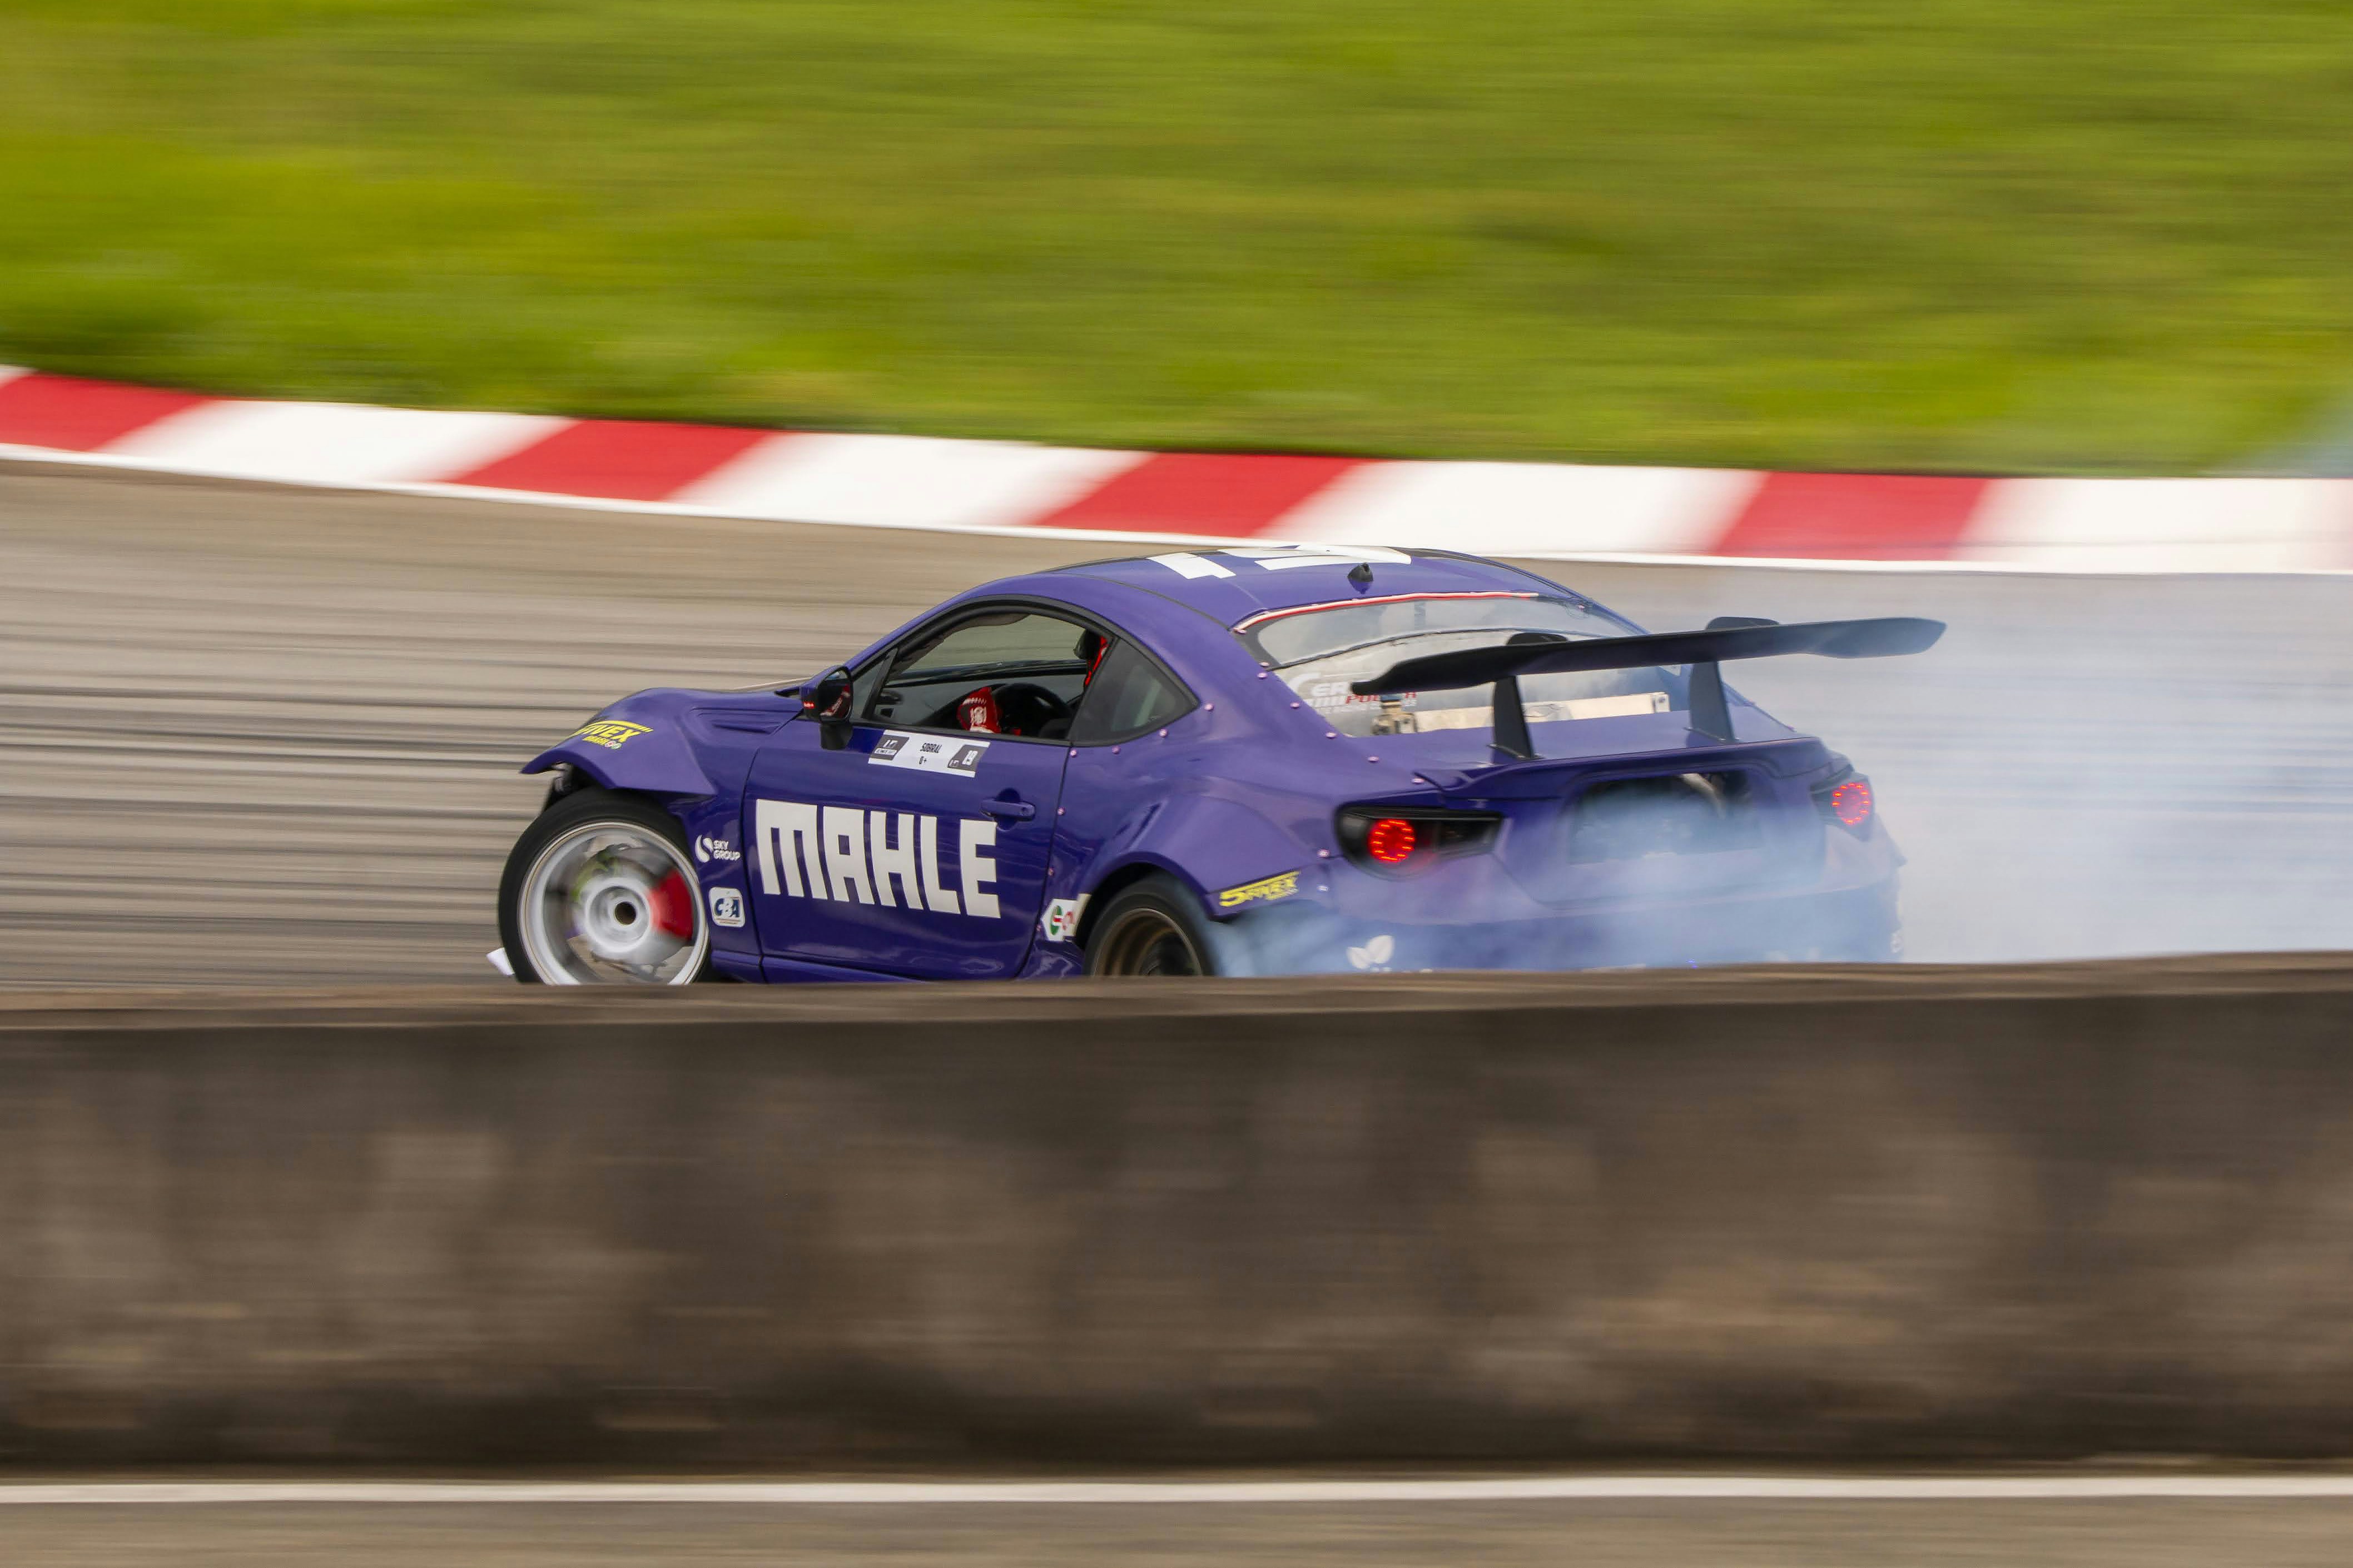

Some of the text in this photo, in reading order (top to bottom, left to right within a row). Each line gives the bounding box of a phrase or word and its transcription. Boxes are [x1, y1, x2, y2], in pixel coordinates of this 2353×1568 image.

[920, 742, 942, 754] SOBRAL
[713, 839, 729, 849] SKY
[713, 850, 741, 860] GROUP
[756, 798, 1001, 919] MAHLE
